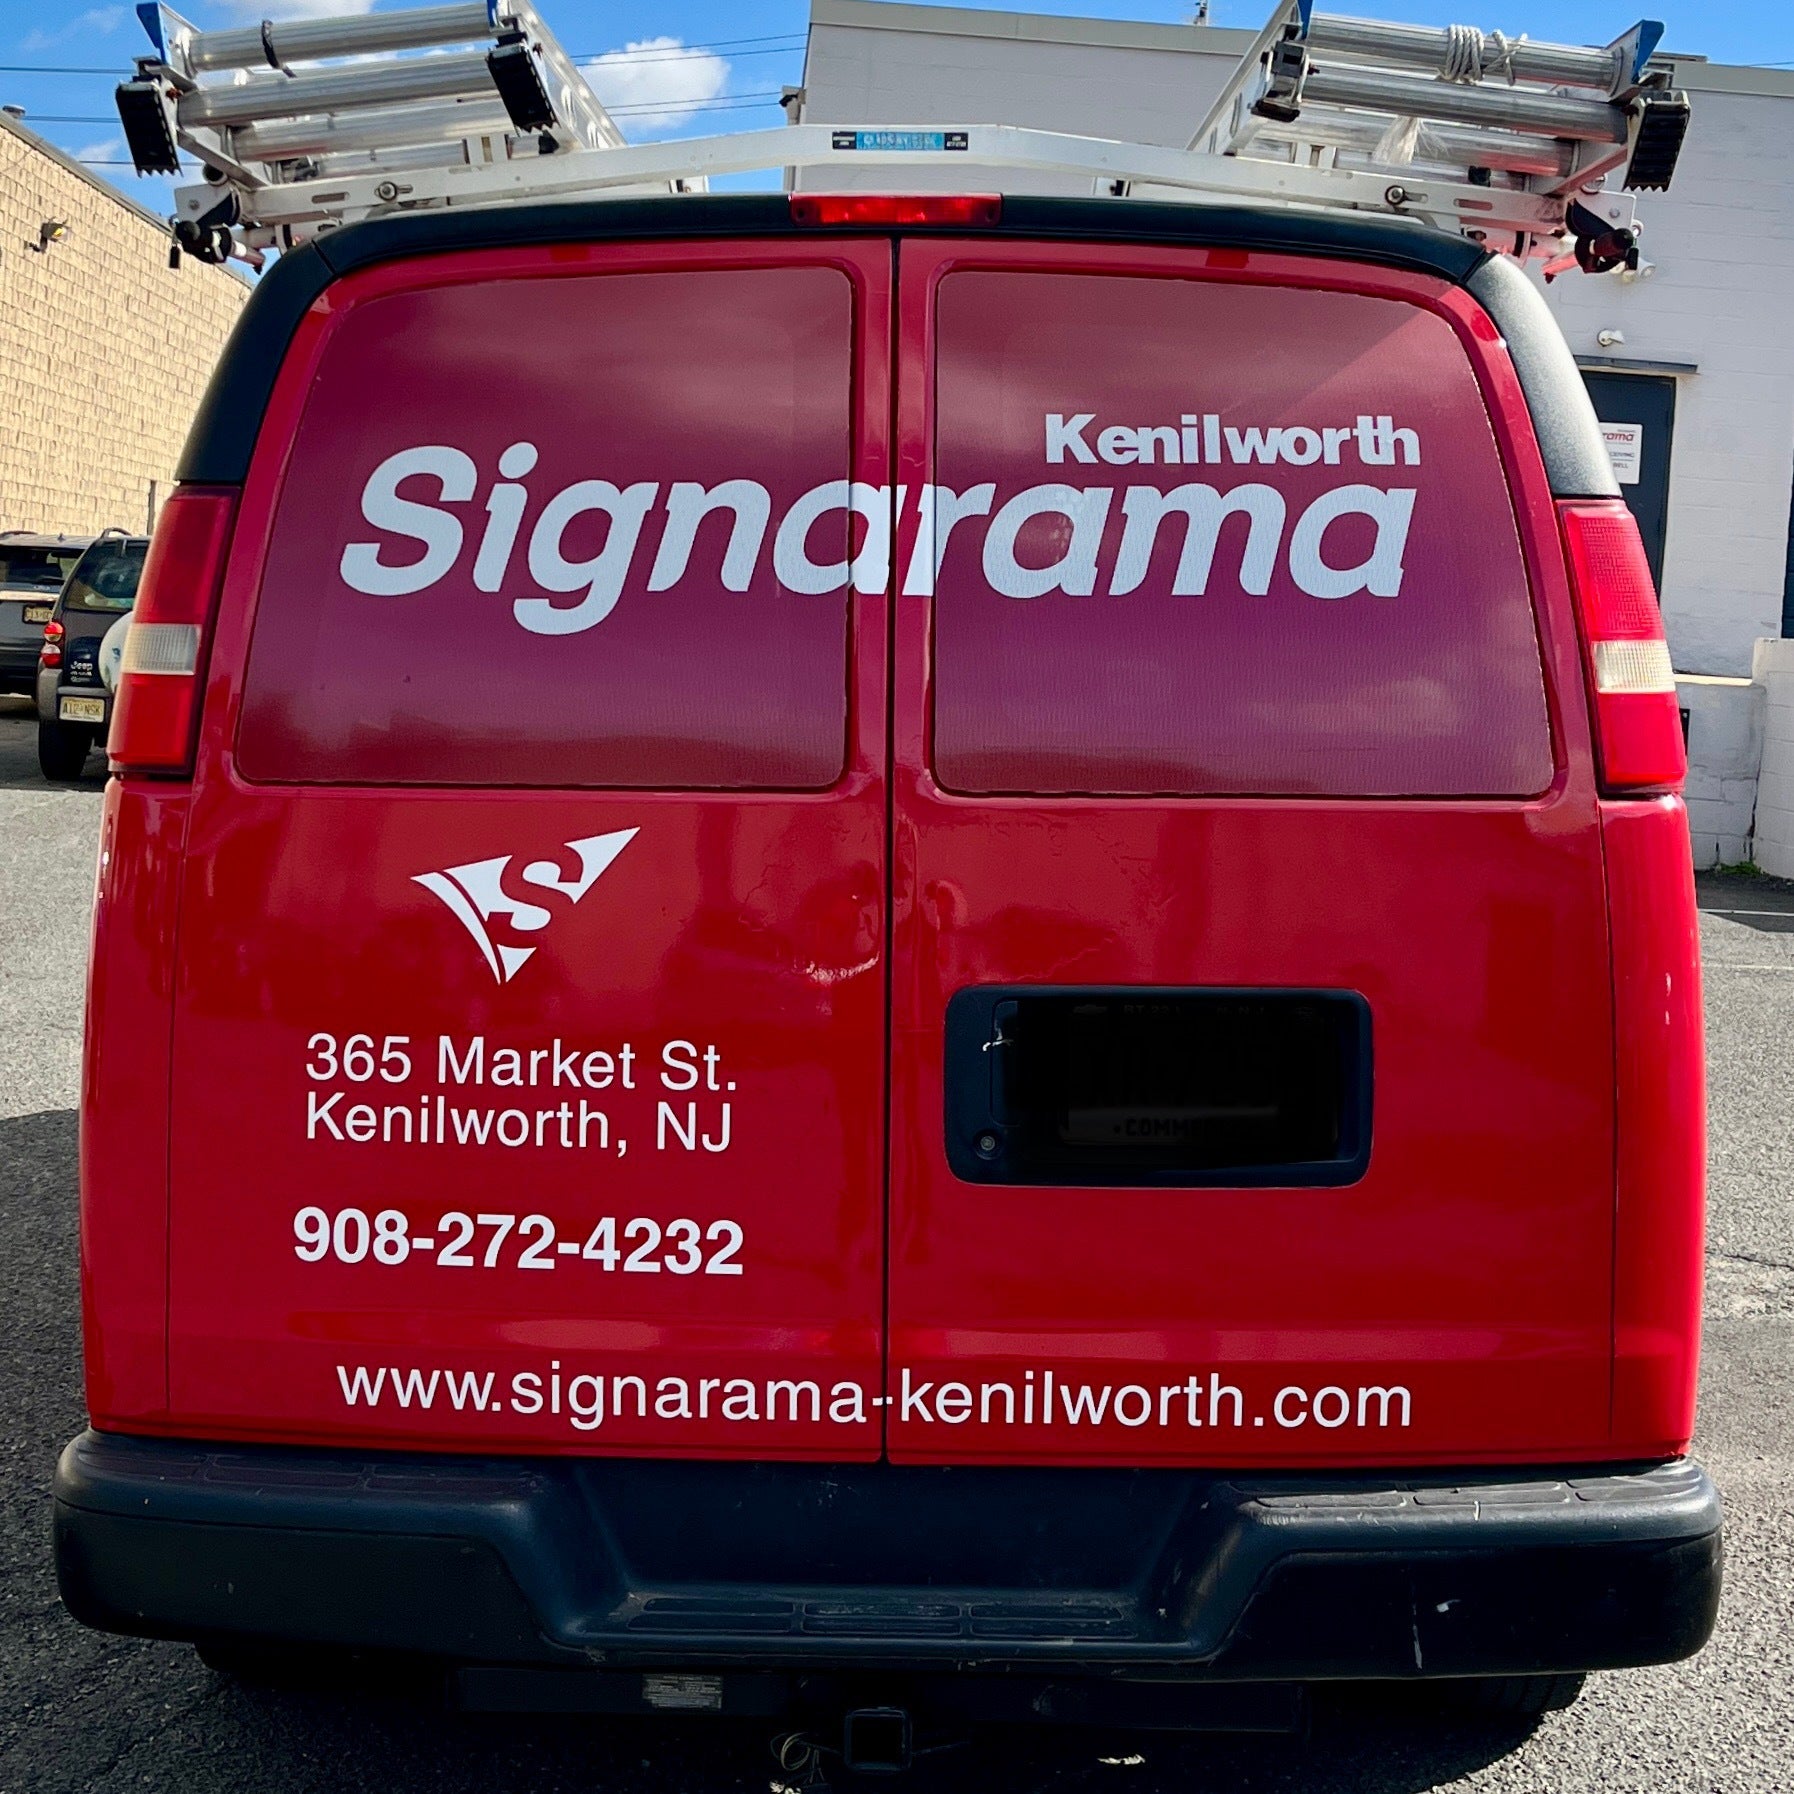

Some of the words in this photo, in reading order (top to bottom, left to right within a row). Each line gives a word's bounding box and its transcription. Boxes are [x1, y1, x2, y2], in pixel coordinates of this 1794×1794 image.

[1045, 413, 1421, 467] Kenilworth
[340, 441, 1417, 636] Signarama
[306, 1032, 412, 1083] 365
[438, 1035, 636, 1089] Market
[660, 1040, 736, 1091] St.
[307, 1091, 628, 1158] Kenilworth,
[657, 1101, 731, 1153] NJ
[293, 1206, 744, 1275] 908-272-4232
[336, 1360, 1411, 1431] www.signarama-kenilworth.com
